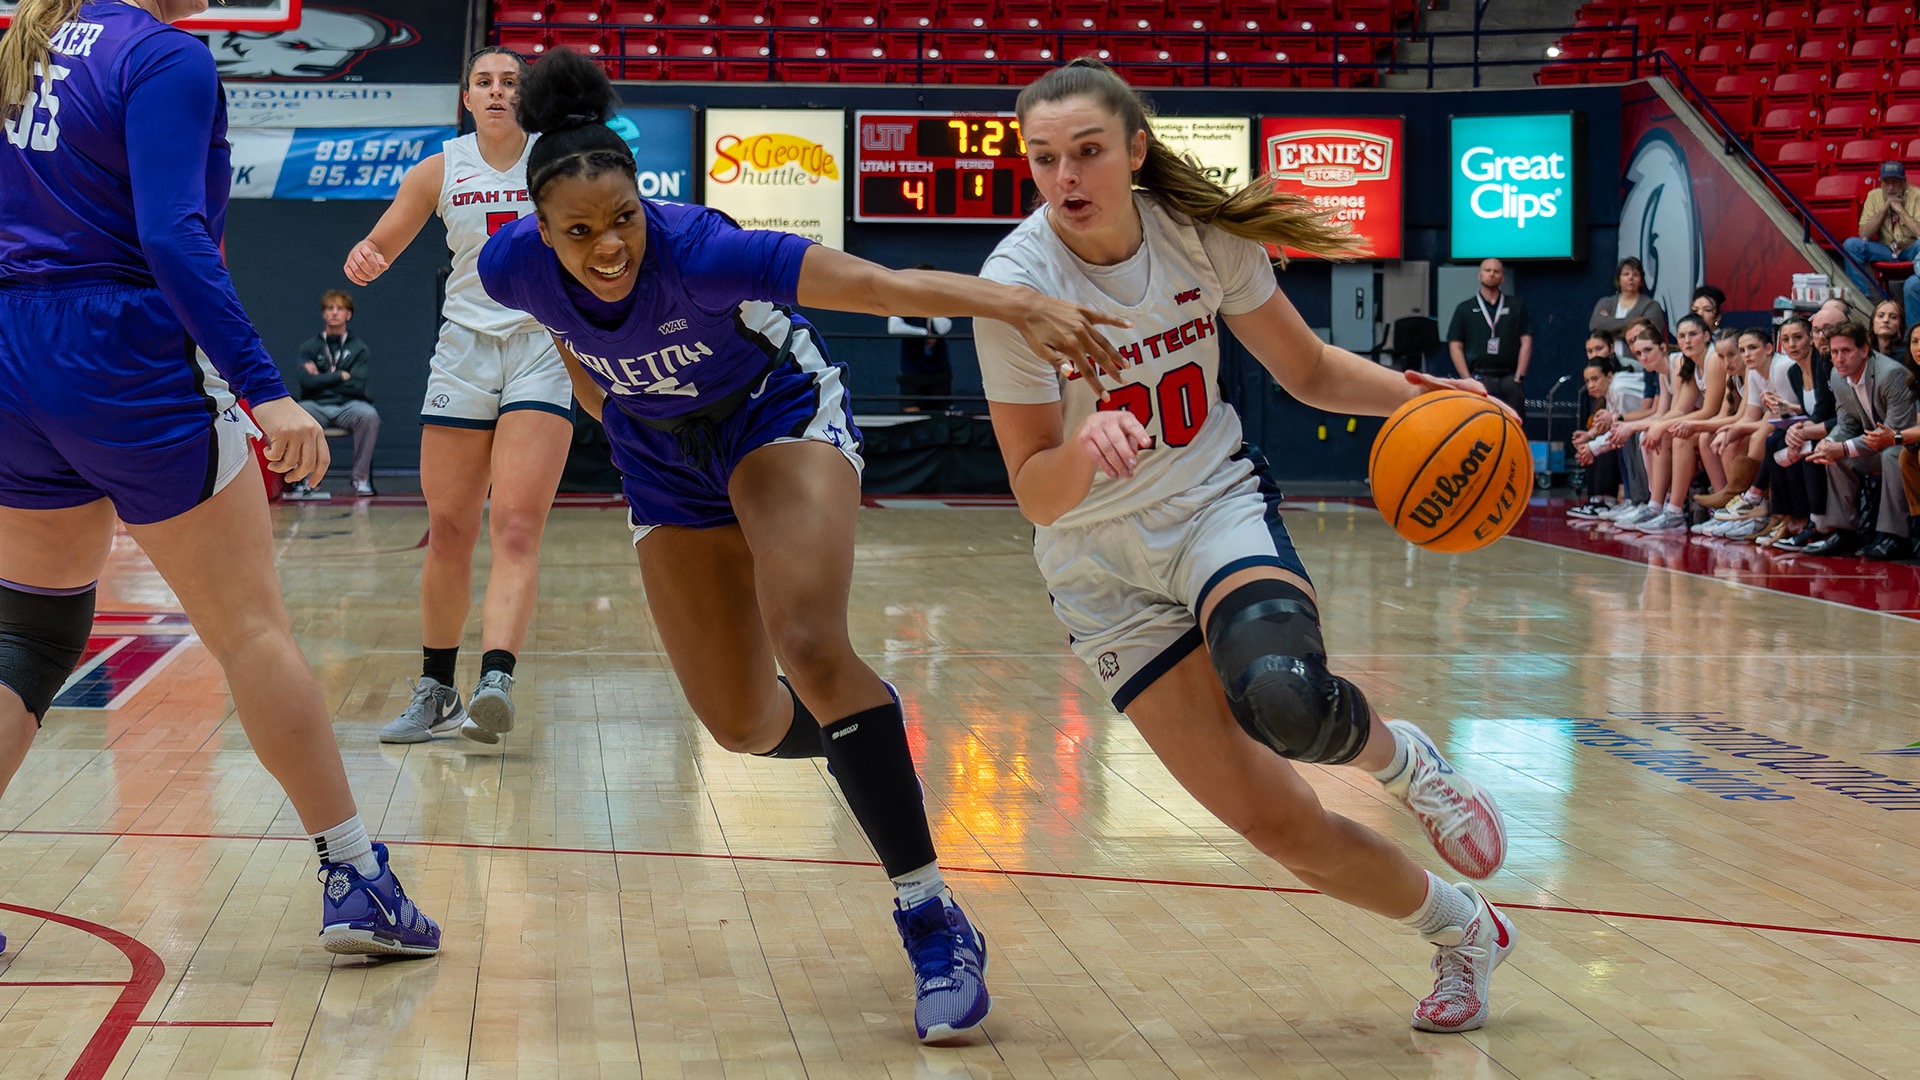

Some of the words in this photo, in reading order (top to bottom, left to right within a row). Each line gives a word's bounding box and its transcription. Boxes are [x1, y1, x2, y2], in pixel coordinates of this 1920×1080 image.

[315, 139, 425, 161] 99.5FM
[752, 135, 834, 184] George
[1276, 141, 1384, 171] ERNIE'S
[860, 160, 895, 172] UTAH
[897, 161, 934, 173] TECH
[955, 159, 994, 169] PERIOD
[1307, 169, 1351, 181] STORES
[1460, 146, 1566, 181] Great
[452, 190, 500, 207] UTAH
[503, 189, 529, 202] TE
[903, 181, 923, 210] 4
[1312, 195, 1366, 208] GEORGE
[1470, 183, 1558, 228] Clips
[1336, 208, 1366, 220] CITY
[658, 318, 689, 335] WAC
[1143, 314, 1216, 360] TECH
[1096, 361, 1208, 450] 20
[1408, 439, 1493, 529] Wilson
